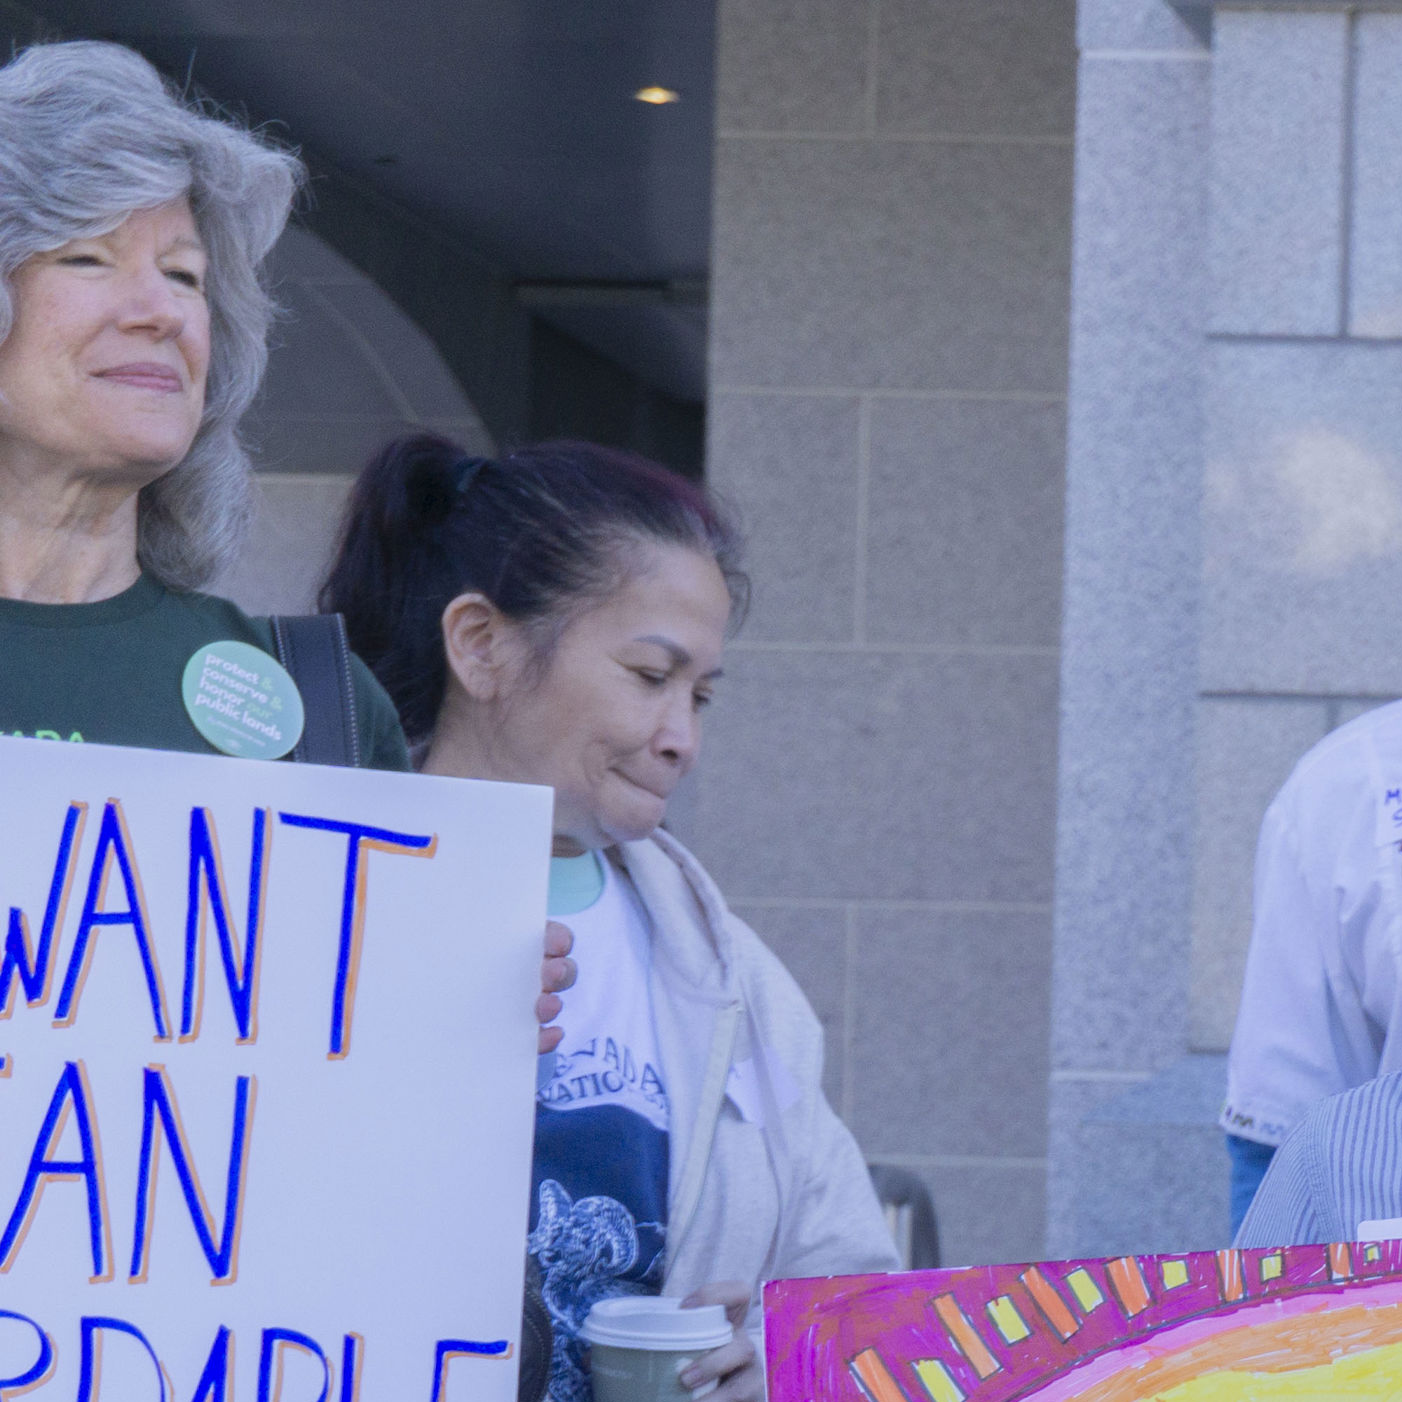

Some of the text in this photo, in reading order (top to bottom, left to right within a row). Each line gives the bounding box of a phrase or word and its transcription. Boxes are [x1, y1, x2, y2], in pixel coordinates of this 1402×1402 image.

[200, 675, 246, 706] honor
[203, 667, 268, 705] conserve
[205, 653, 260, 685] protect
[194, 693, 241, 721] public
[241, 710, 282, 741] lands
[0, 797, 437, 1060] WANT
[0, 1053, 258, 1286] AN
